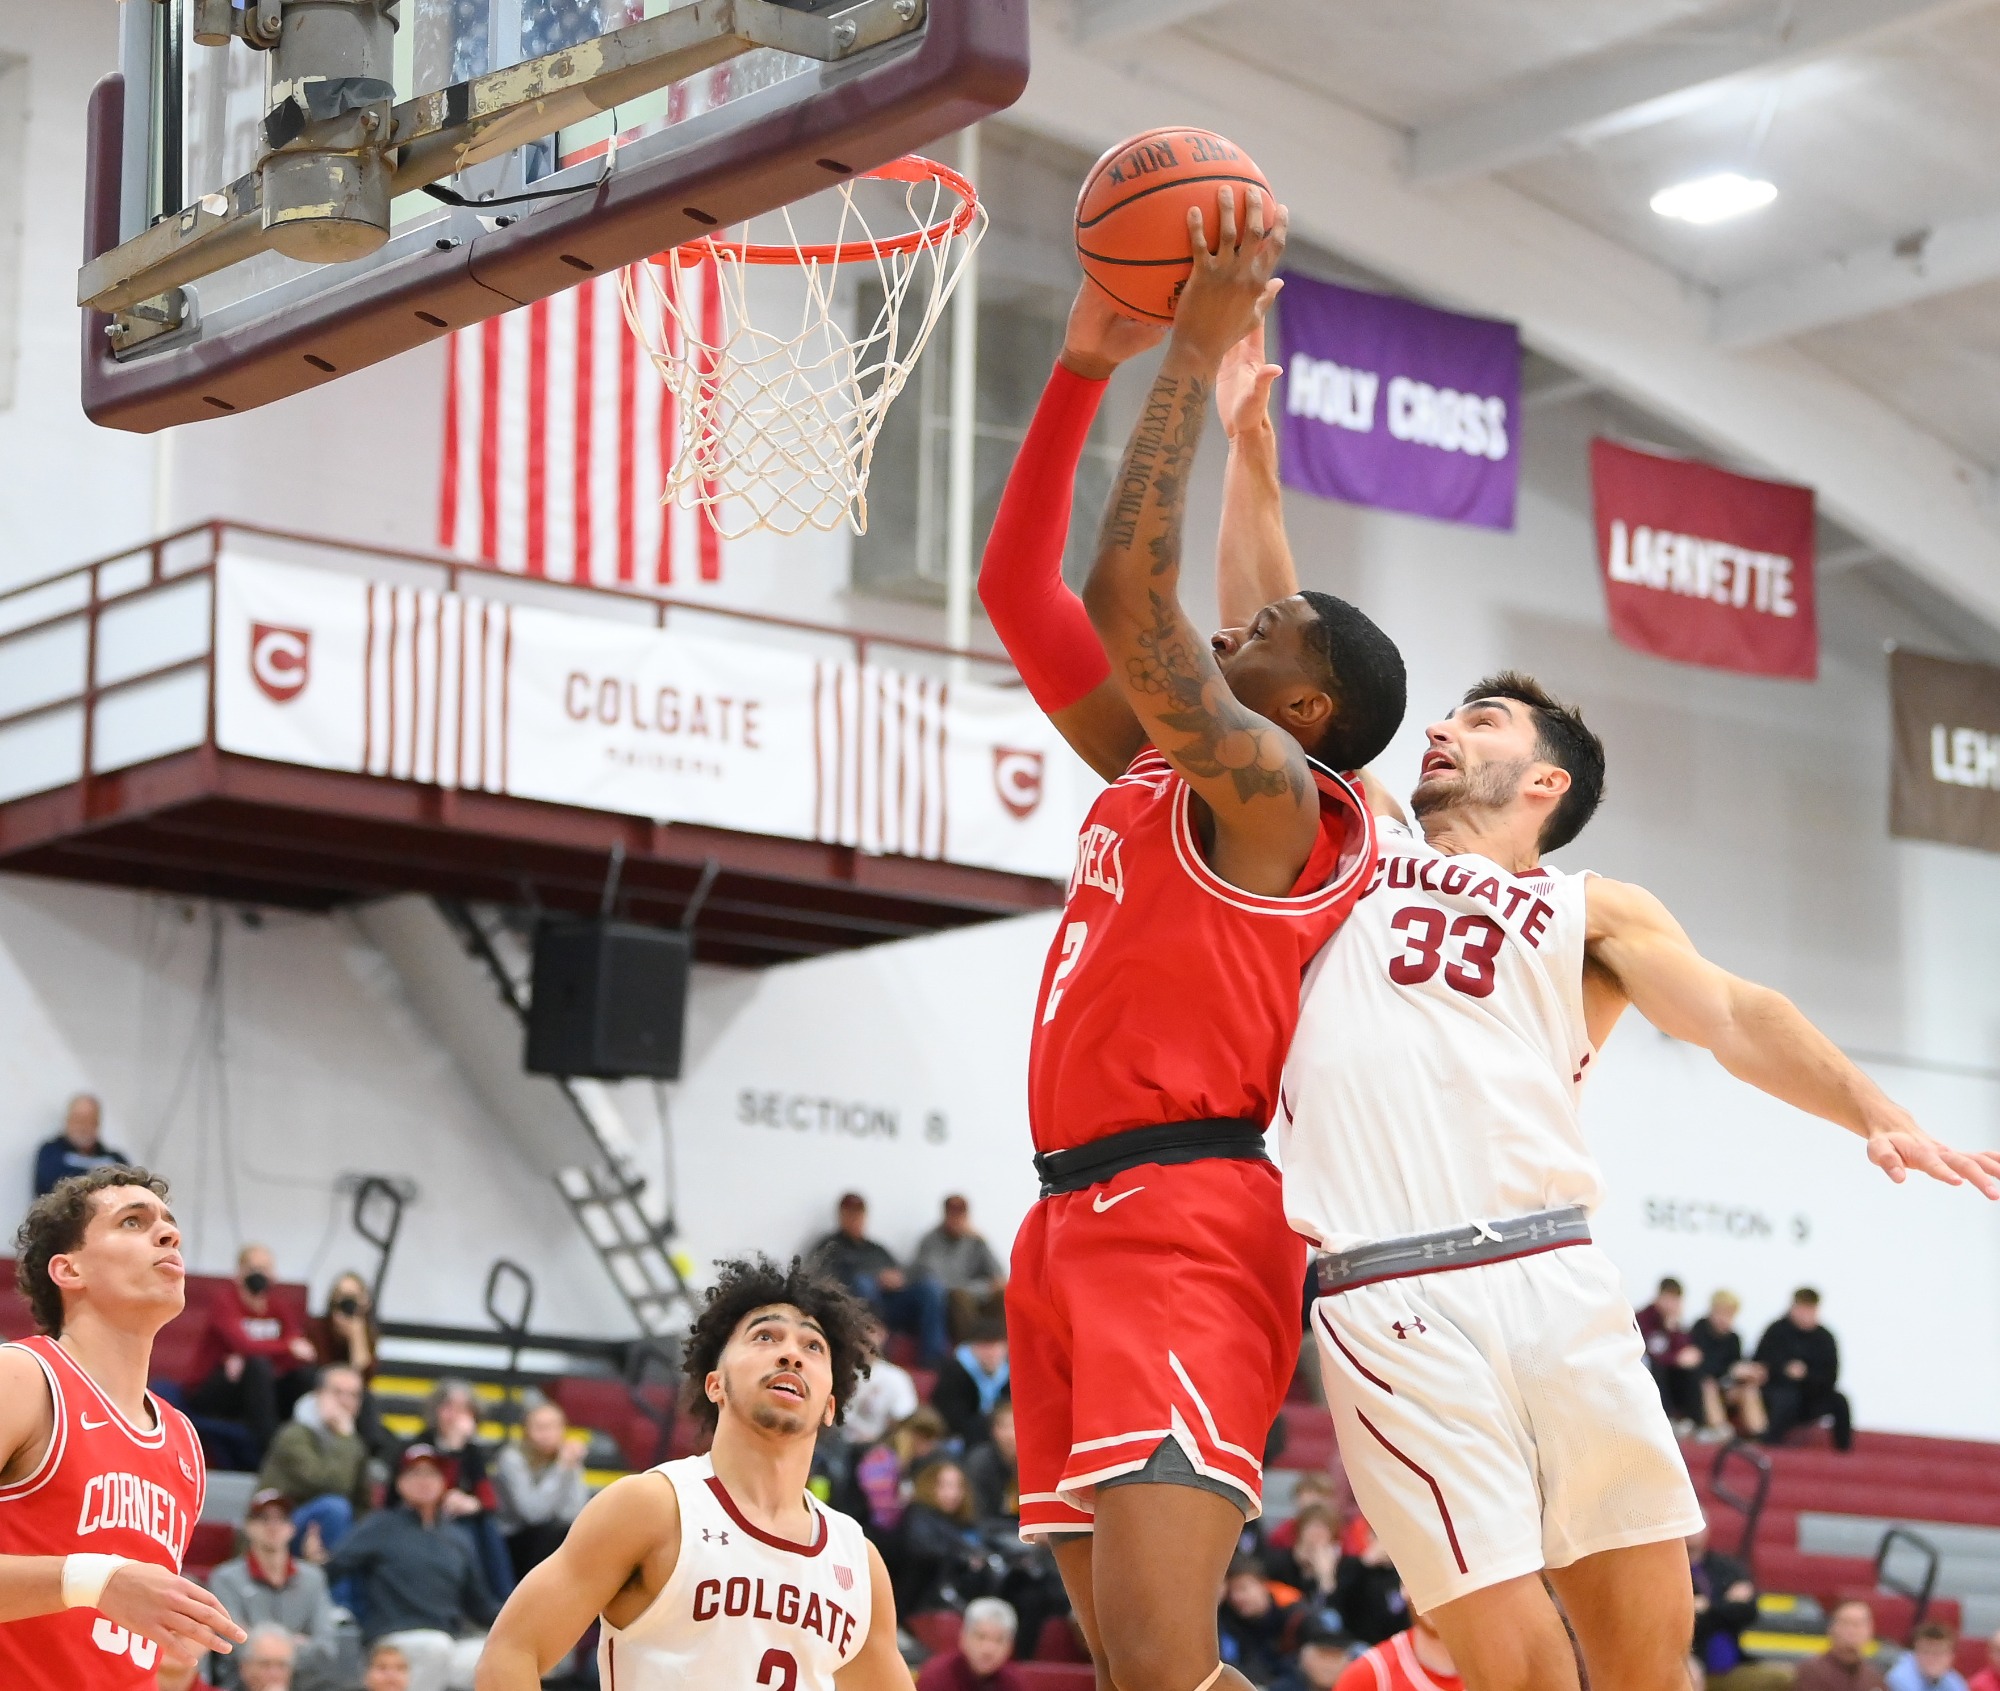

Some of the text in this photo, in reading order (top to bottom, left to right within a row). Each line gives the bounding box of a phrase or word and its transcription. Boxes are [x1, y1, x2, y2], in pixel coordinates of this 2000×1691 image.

[1106, 138, 1180, 187] ROCK
[1287, 352, 1509, 461] HOLY CROSS
[1608, 519, 1796, 618] LAFAYETTE
[254, 630, 306, 687] C
[564, 671, 763, 750] COLGATE
[997, 755, 1042, 807] C
[1358, 856, 1555, 949] COLGATE
[1389, 906, 1506, 999] 33
[737, 1088, 899, 1140] SECTION
[692, 1577, 856, 1659] COLGATE
